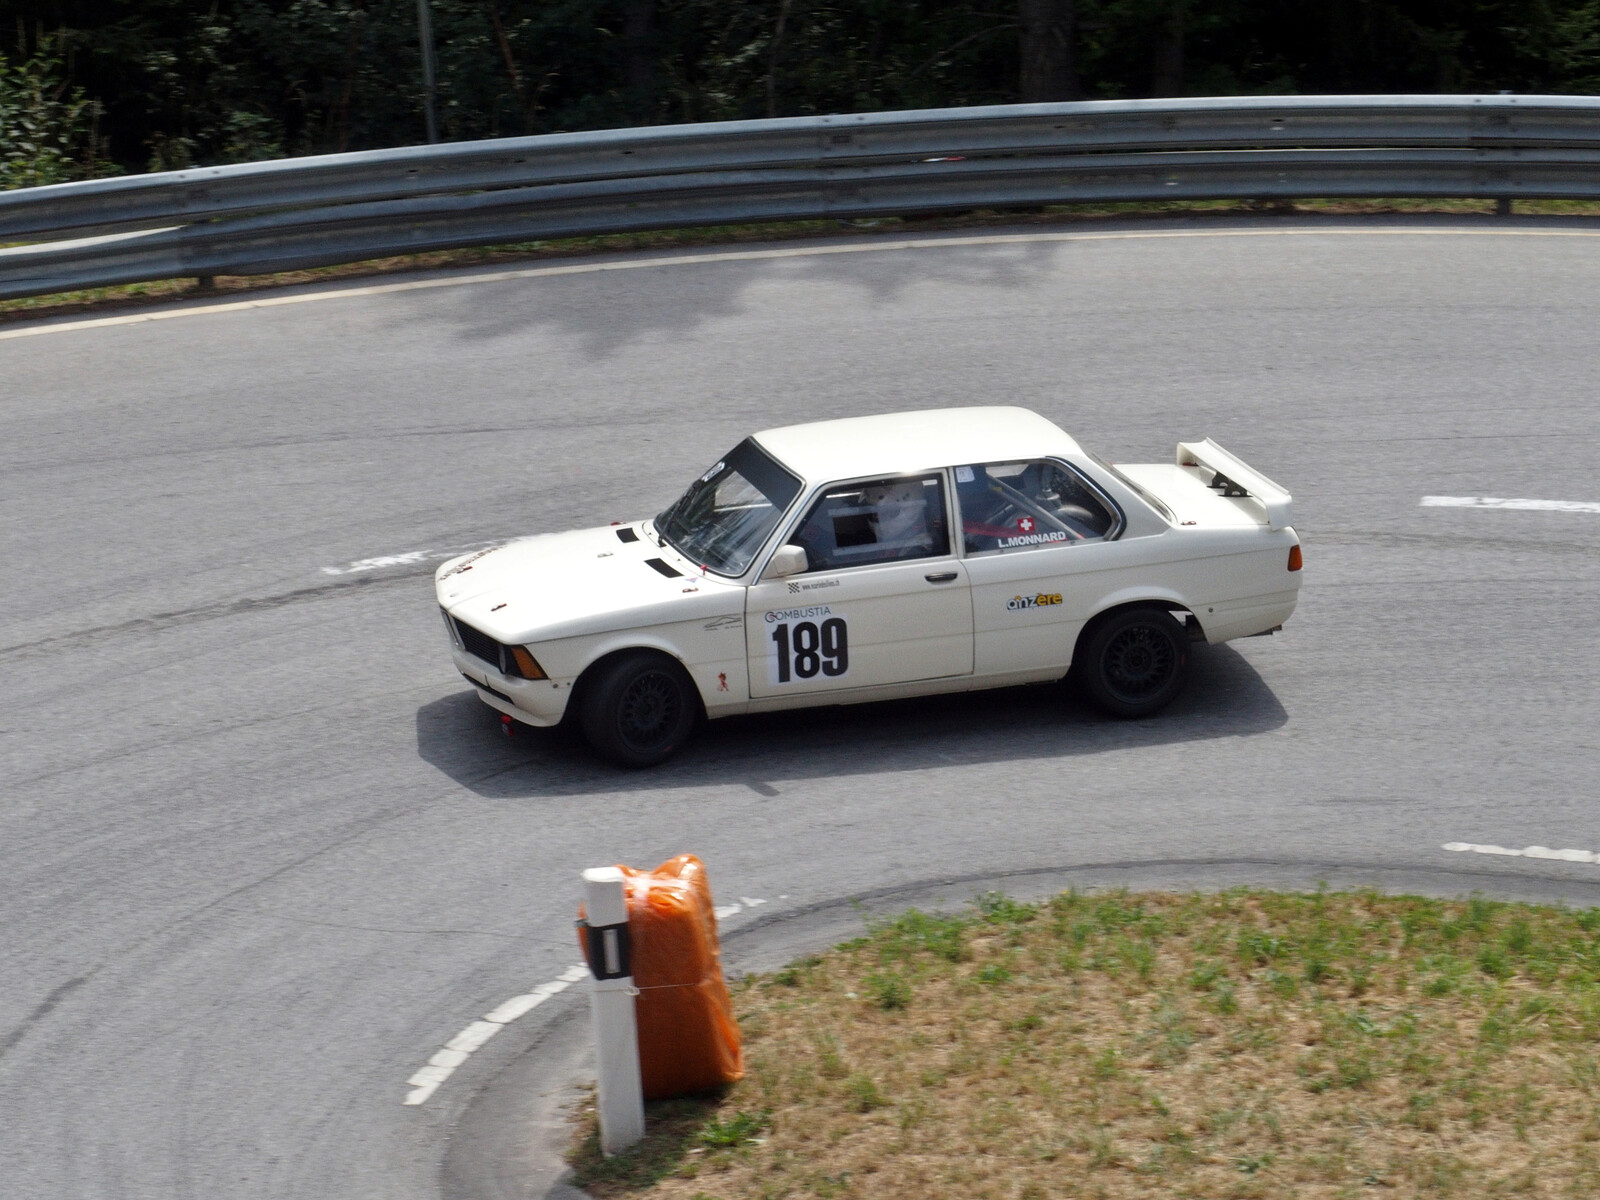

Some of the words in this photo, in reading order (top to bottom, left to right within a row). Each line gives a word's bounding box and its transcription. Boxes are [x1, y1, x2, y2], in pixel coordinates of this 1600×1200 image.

[997, 531, 1067, 549] L.MONNARD
[764, 606, 832, 624] COMBUSTIA
[772, 617, 849, 684] 189
